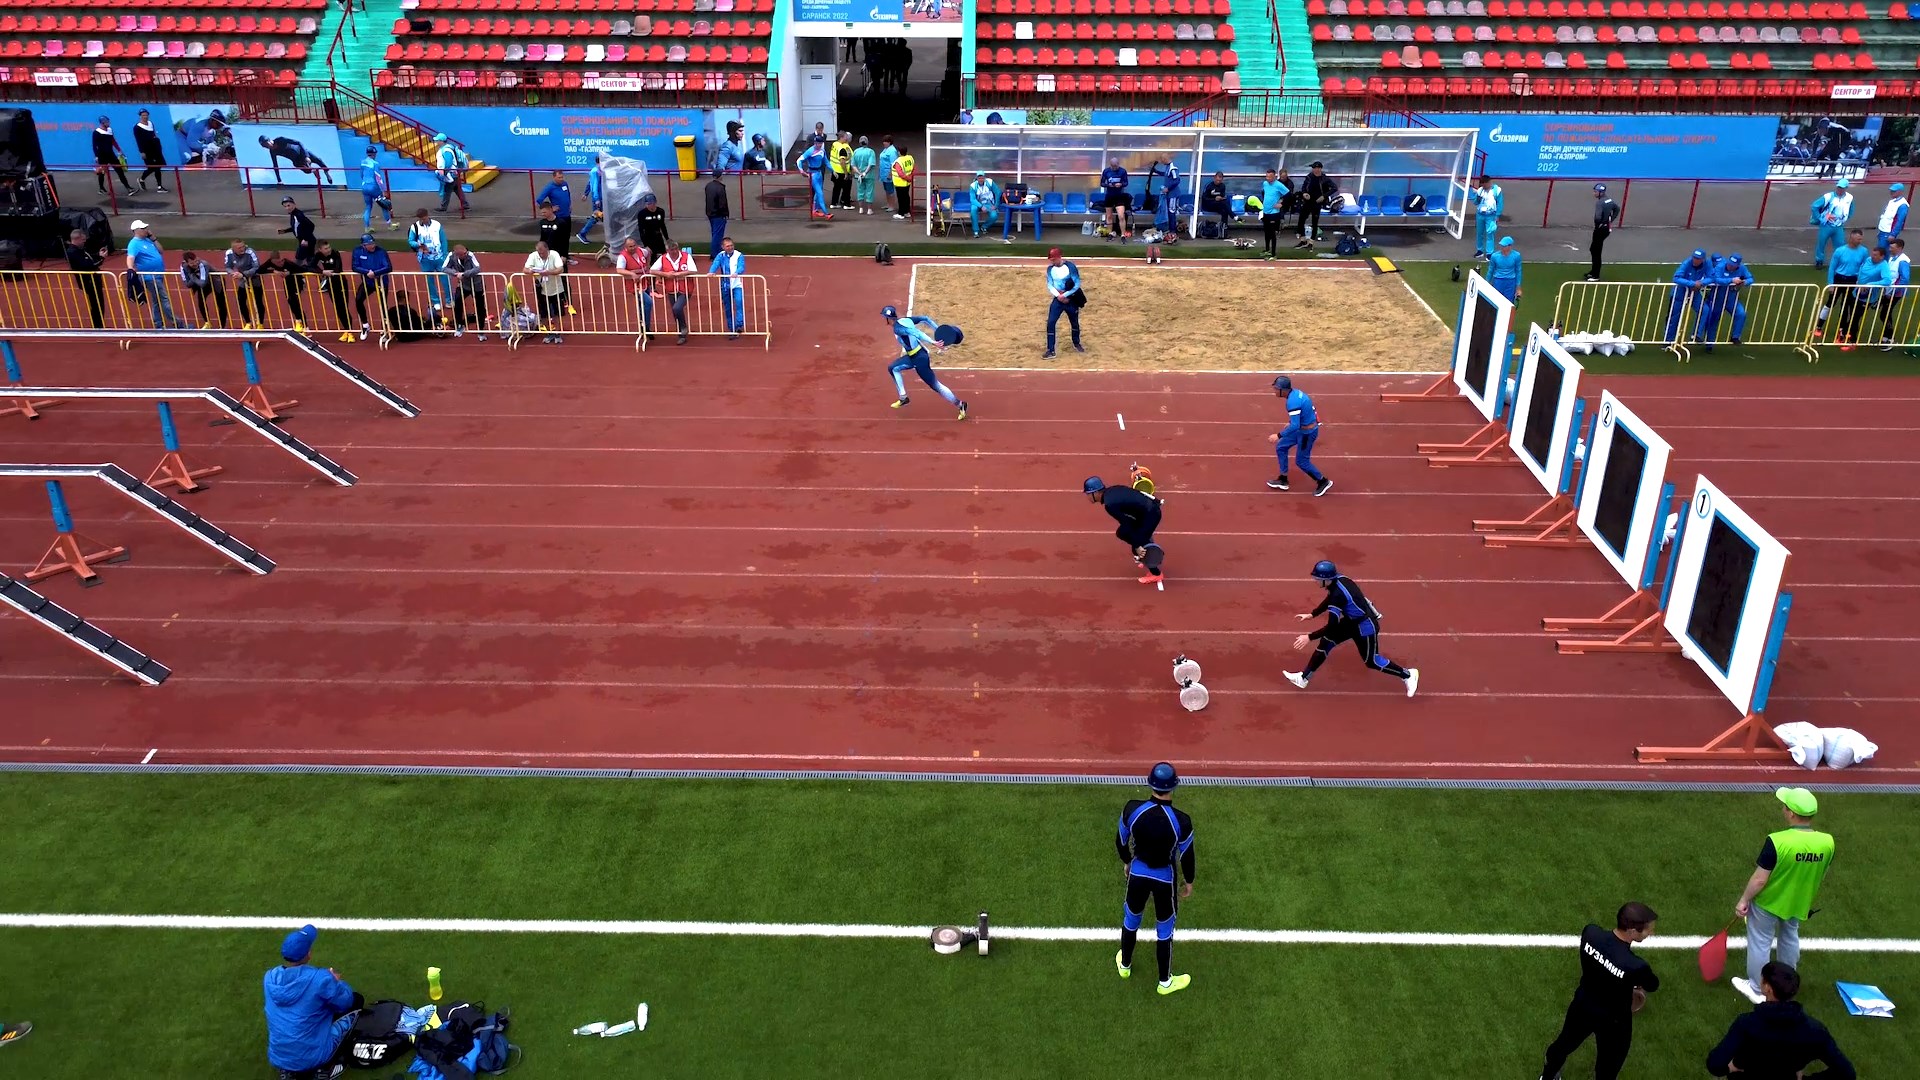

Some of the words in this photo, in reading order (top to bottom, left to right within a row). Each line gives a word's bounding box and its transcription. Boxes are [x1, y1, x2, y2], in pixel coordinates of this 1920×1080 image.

[802, 12, 831, 20] САРАНСК
[833, 12, 849, 20] 2022
[37, 75, 64, 83] СЕКТОР
[600, 80, 628, 88] СЕКТОР
[1834, 88, 1863, 96] СЕКТОР
[561, 115, 629, 125] СОРЕВНОВАНИЯ
[639, 127, 673, 136] СПОРТУ
[563, 138, 584, 146] СРЕДИ
[585, 138, 619, 146] ДОЧЕРНИХ
[620, 138, 650, 146] ОБЩЕСТВ
[564, 145, 578, 153] ПАО
[1540, 145, 1562, 153] СРЕДИ
[1562, 145, 1596, 153] ДОЧЕРНИХ
[566, 155, 588, 165] 2022
[1536, 162, 1560, 172] 2022
[1795, 852, 1824, 863] СУДЬЯ
[1584, 942, 1625, 979] КУЗЬМИН
